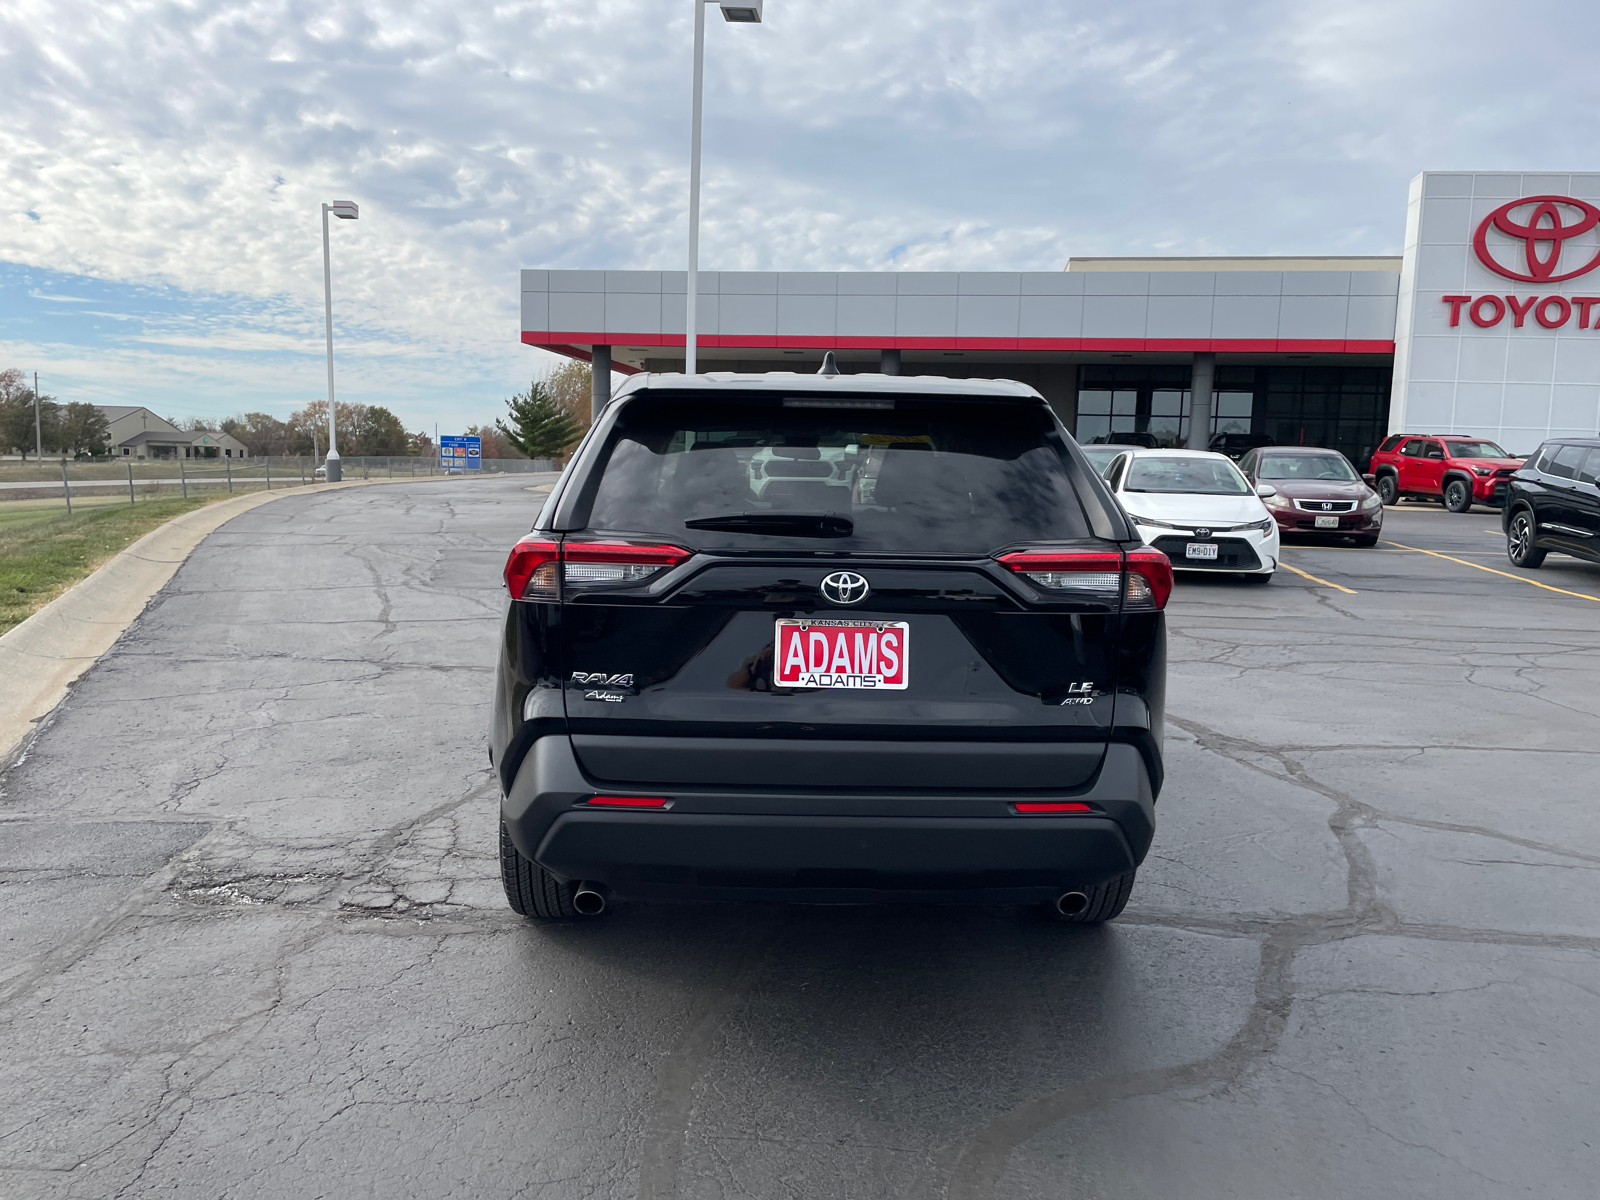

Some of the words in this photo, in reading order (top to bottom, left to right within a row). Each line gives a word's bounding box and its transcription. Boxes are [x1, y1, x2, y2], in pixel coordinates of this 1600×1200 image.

[784, 632, 898, 677] ADAMS
[570, 672, 634, 688] RAV4
[805, 674, 876, 687] ADAMS
[1068, 682, 1094, 693] LE
[586, 690, 624, 700] Adams
[1060, 698, 1094, 706] AWD
